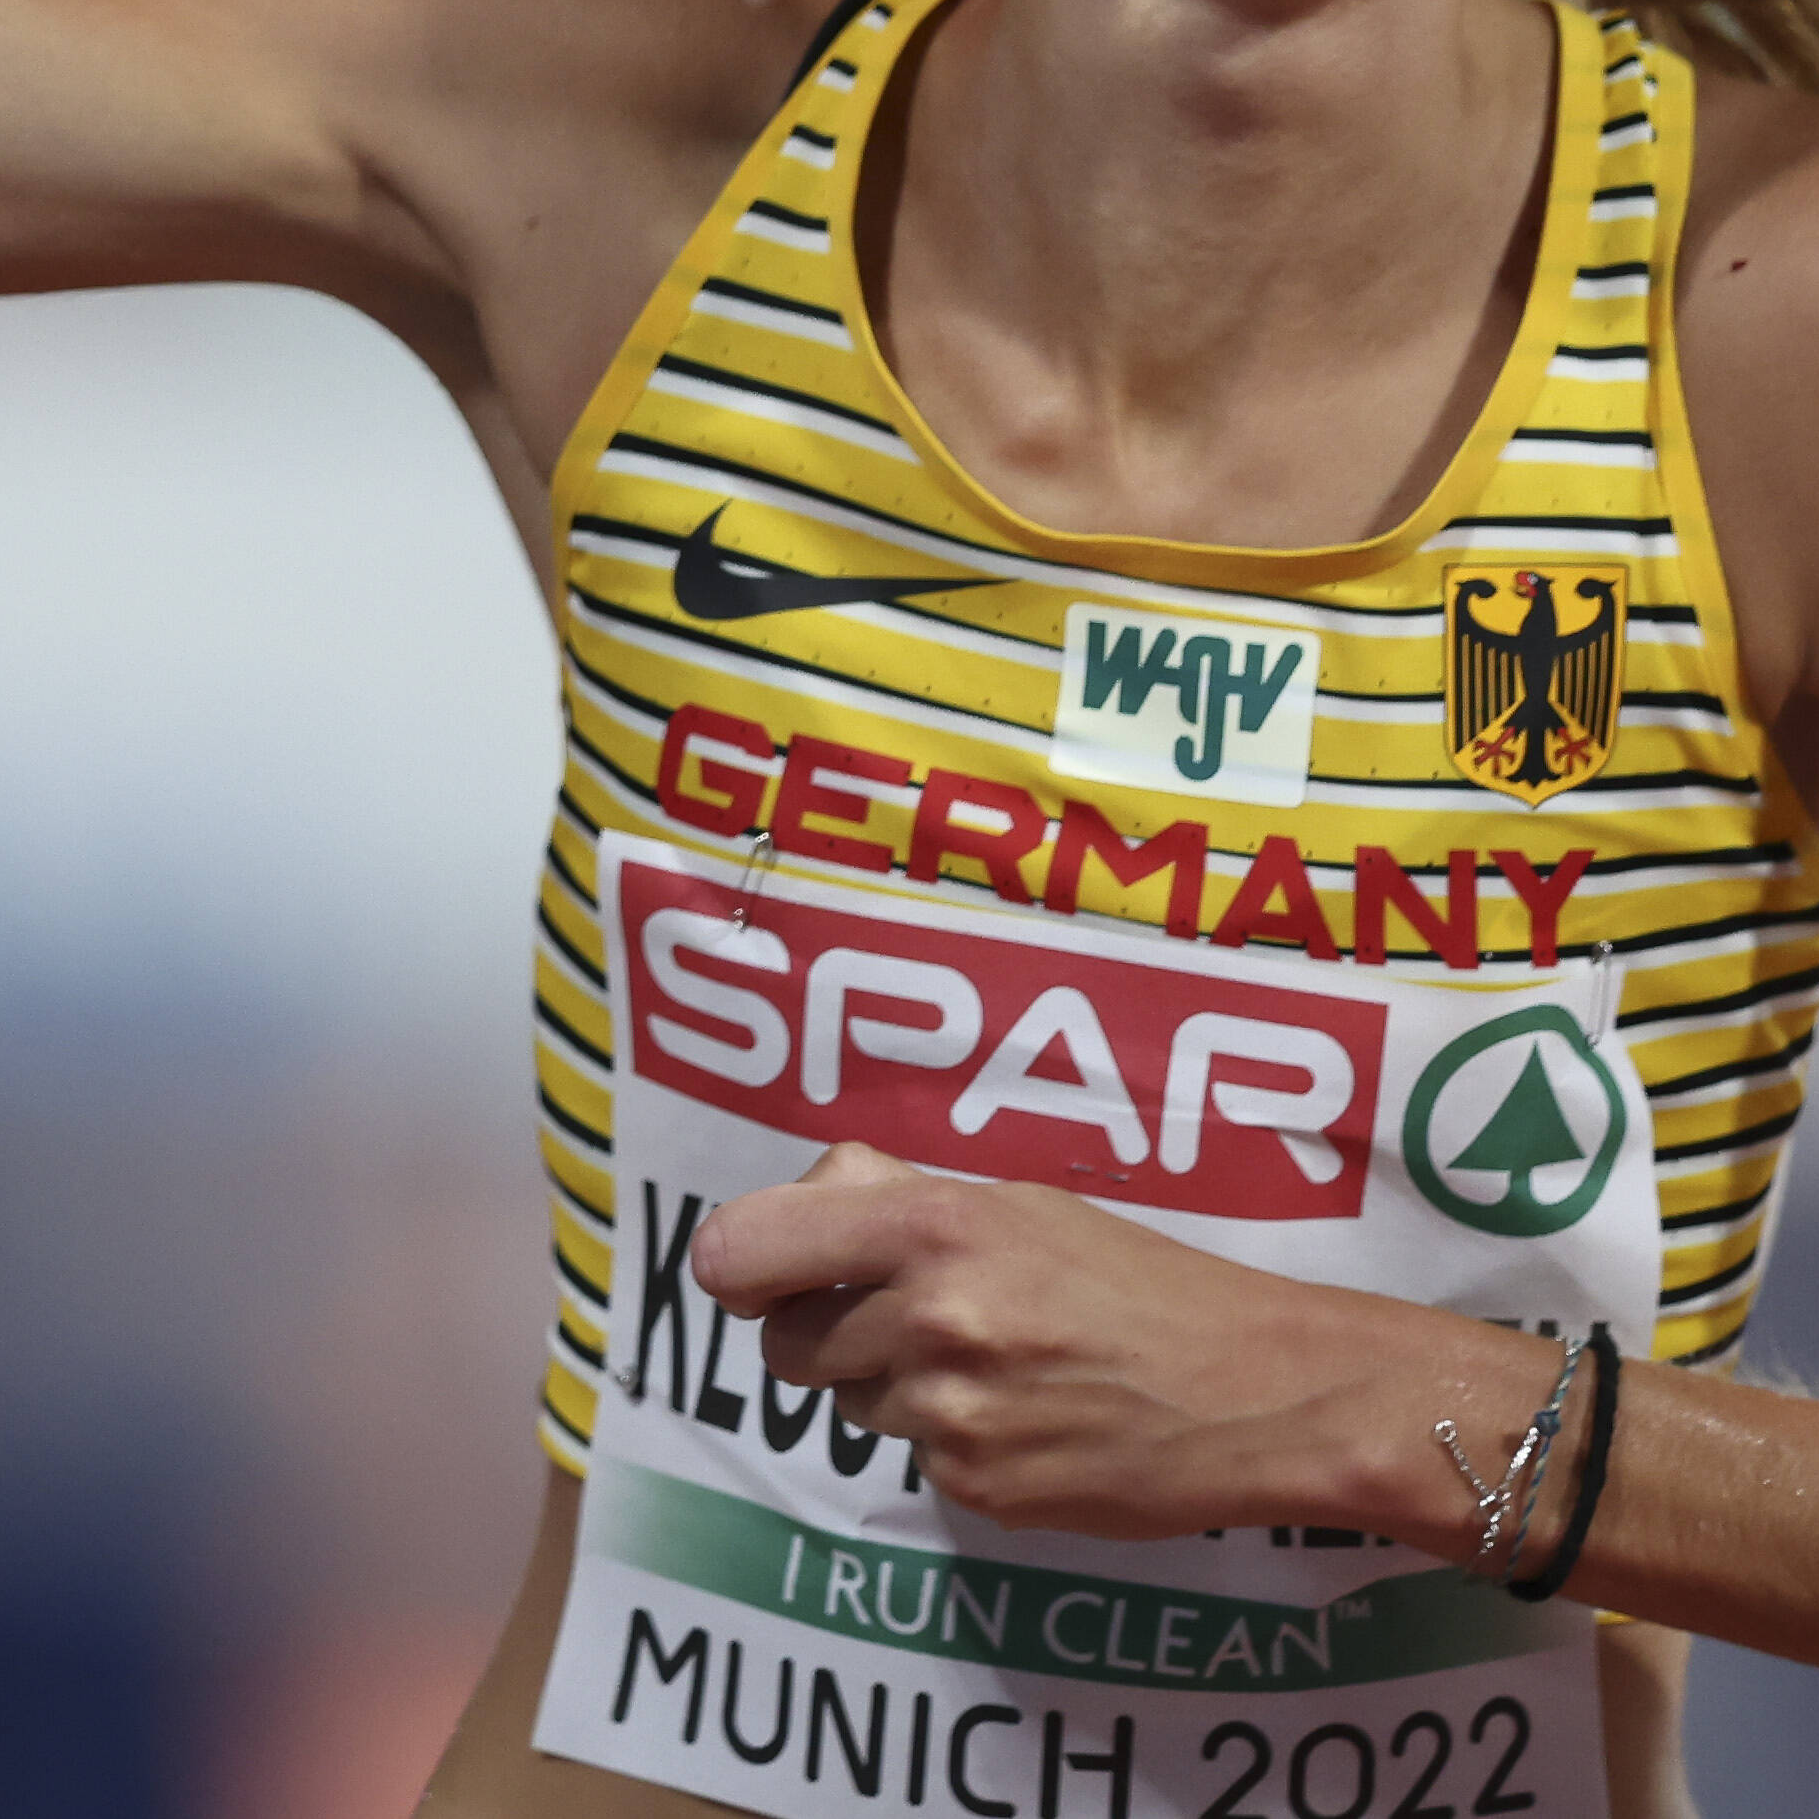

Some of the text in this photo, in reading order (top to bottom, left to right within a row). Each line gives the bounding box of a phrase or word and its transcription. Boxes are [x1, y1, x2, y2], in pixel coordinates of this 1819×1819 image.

[656, 701, 1596, 972] GERMANY
[640, 906, 1355, 1185] SPAR
[781, 1533, 805, 1603] I
[824, 1549, 1010, 1651] RUN
[611, 1608, 1537, 1819] MUNICH 2022
